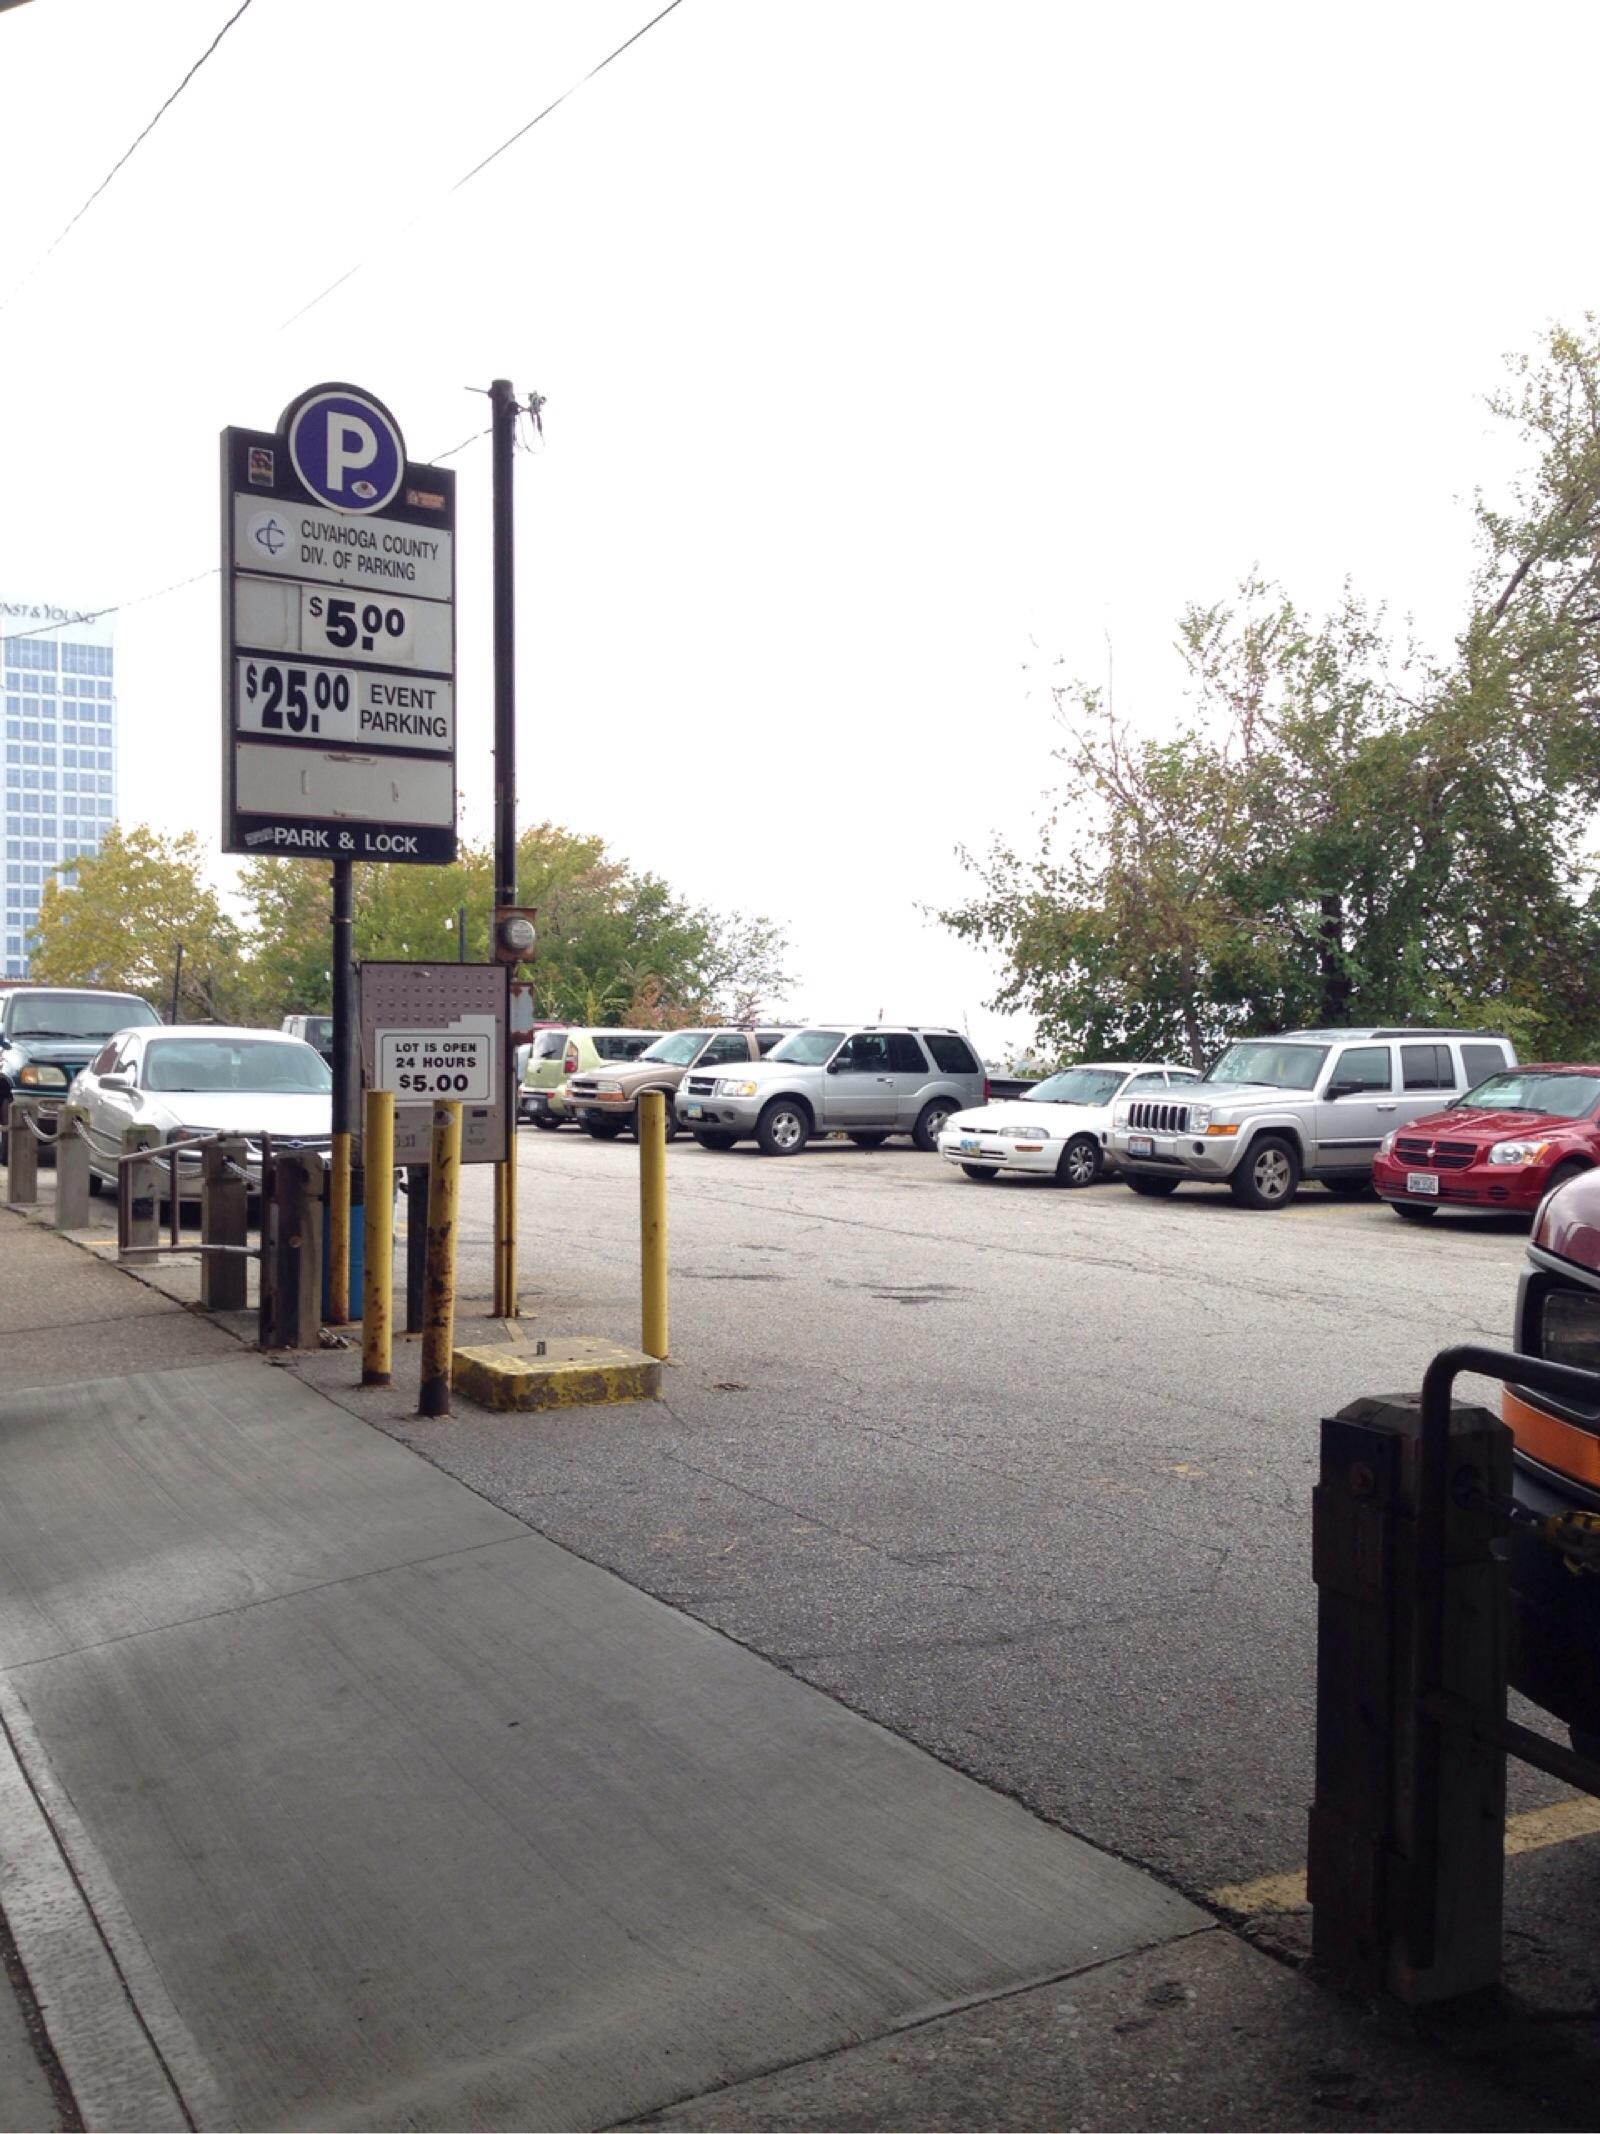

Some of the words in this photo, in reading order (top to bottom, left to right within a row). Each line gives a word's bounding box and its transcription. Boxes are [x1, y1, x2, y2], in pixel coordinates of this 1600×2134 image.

[326, 410, 378, 492] P
[301, 519, 378, 551] CUYAHOGA
[382, 534, 439, 561] COUNTY
[301, 544, 328, 567] DIV.
[332, 550, 352, 569] OF
[357, 554, 416, 582] PARKING
[0, 601, 29, 617] NST
[309, 596, 405, 651] $5.00
[246, 662, 349, 733] $25.00
[370, 683, 437, 711] EVENT
[359, 708, 448, 739] PARKING
[273, 826, 330, 849] PARK
[339, 830, 355, 850] &
[364, 832, 419, 854] LOCK
[395, 1043, 419, 1053] LOT
[424, 1043, 437, 1053] IS
[442, 1043, 477, 1053] OPEN
[396, 1057, 415, 1068] 24
[422, 1057, 476, 1068] HOURS
[399, 1074, 468, 1092] $5.00
